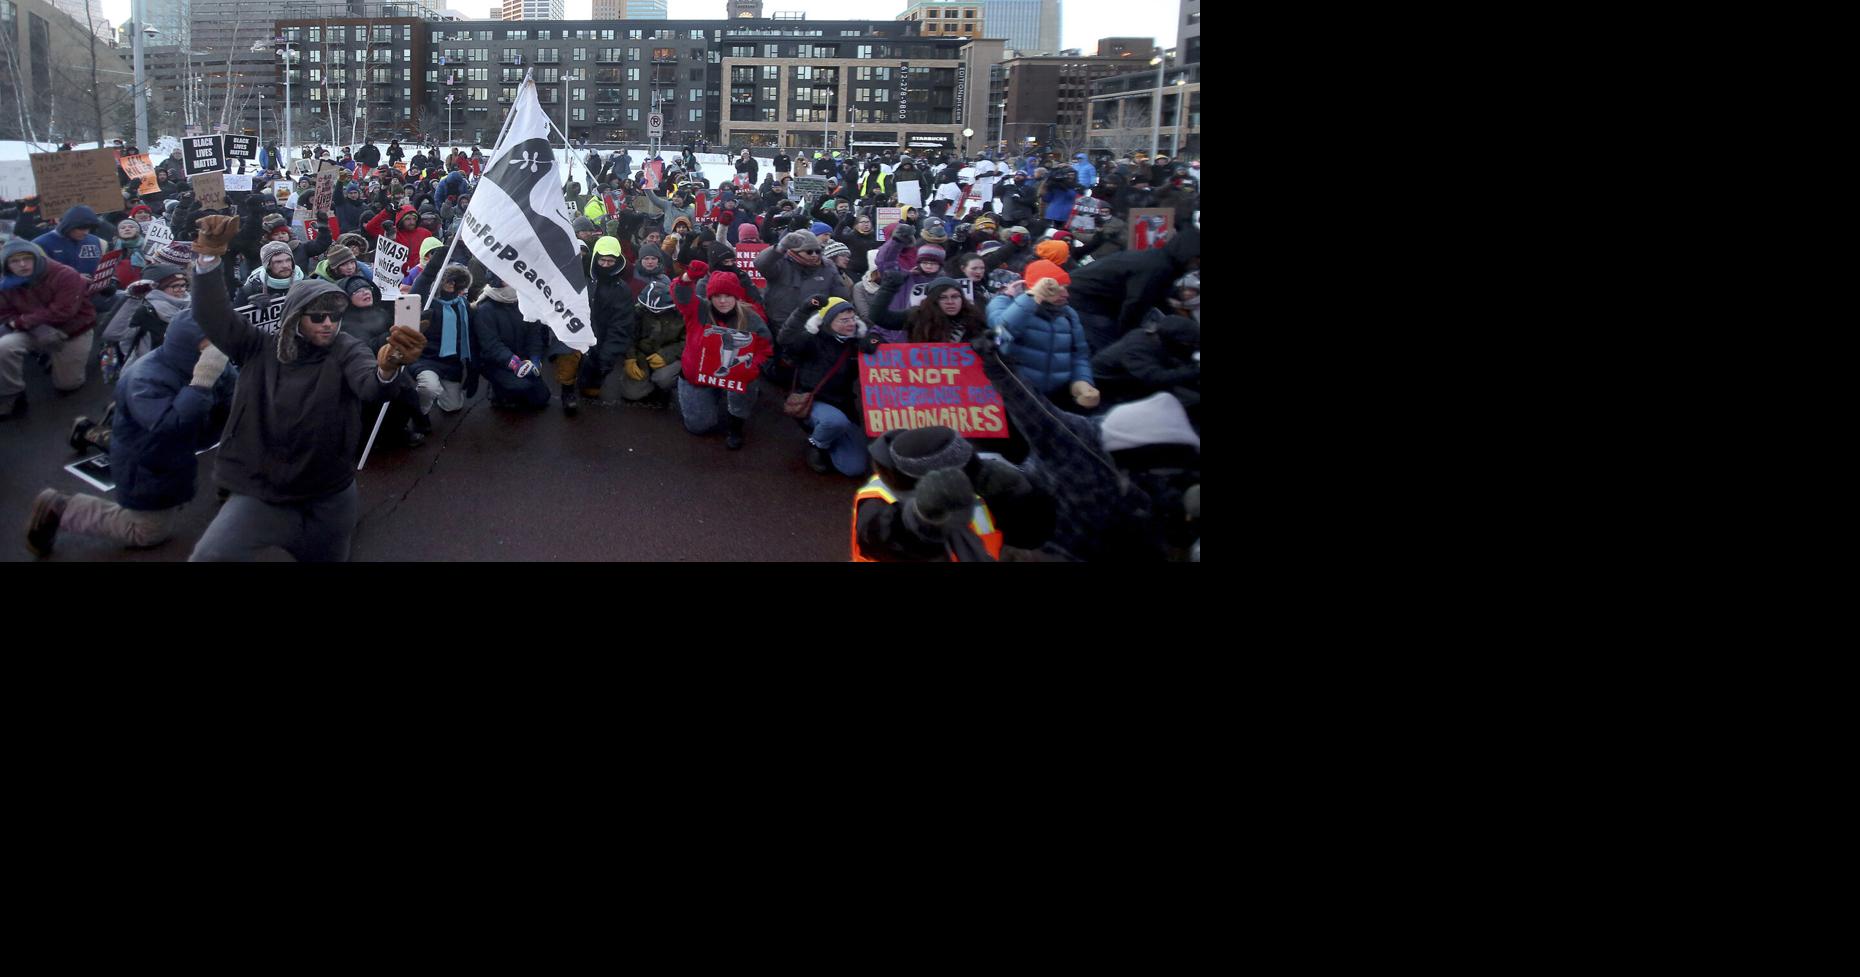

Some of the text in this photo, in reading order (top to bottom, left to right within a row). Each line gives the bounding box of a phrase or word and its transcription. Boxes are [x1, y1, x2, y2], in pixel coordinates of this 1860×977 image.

[192, 137, 214, 148] BLACK
[195, 148, 213, 158] LIVES
[193, 158, 218, 169] MATTER
[379, 257, 400, 275] white
[736, 260, 755, 268] STA
[864, 346, 906, 368] OUR
[697, 373, 743, 391] KNEEL
[869, 368, 961, 384] ARE NOT
